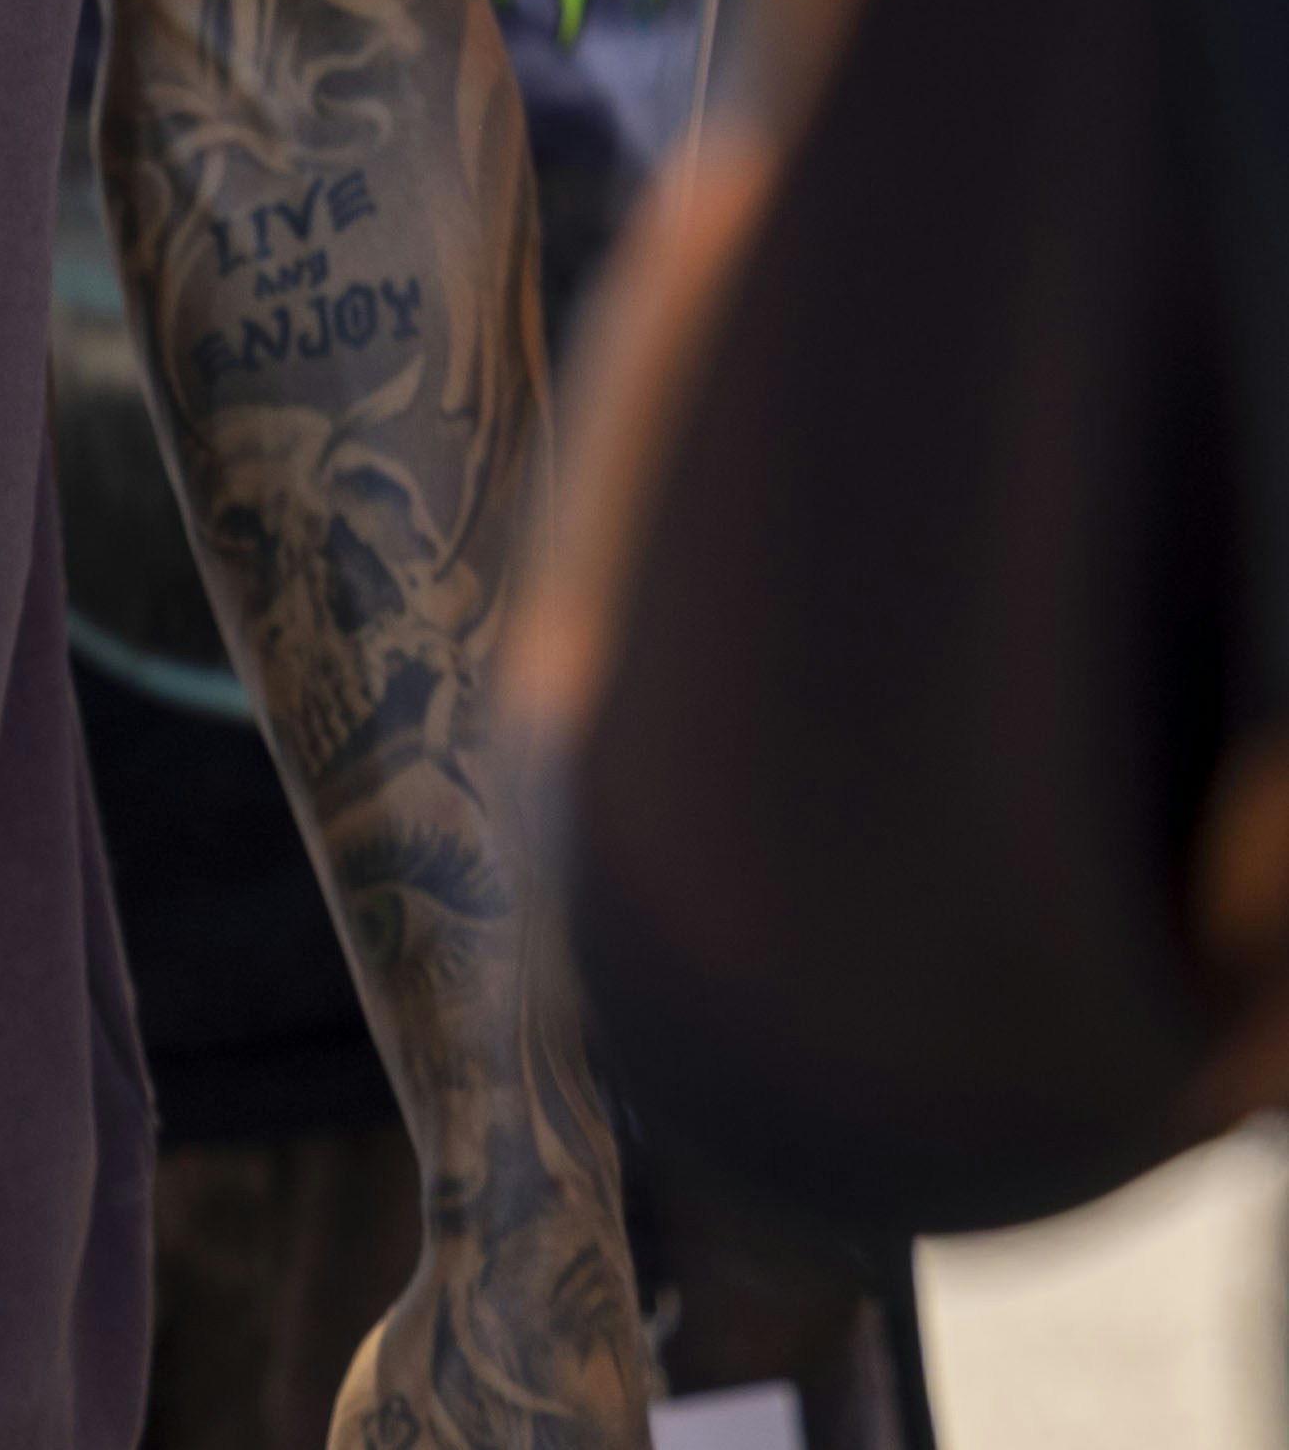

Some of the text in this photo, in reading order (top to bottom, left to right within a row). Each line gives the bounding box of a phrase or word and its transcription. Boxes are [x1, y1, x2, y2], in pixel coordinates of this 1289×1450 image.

[209, 166, 377, 279] LIVE
[195, 276, 421, 383] ENJOY
[253, 252, 329, 301] AND
